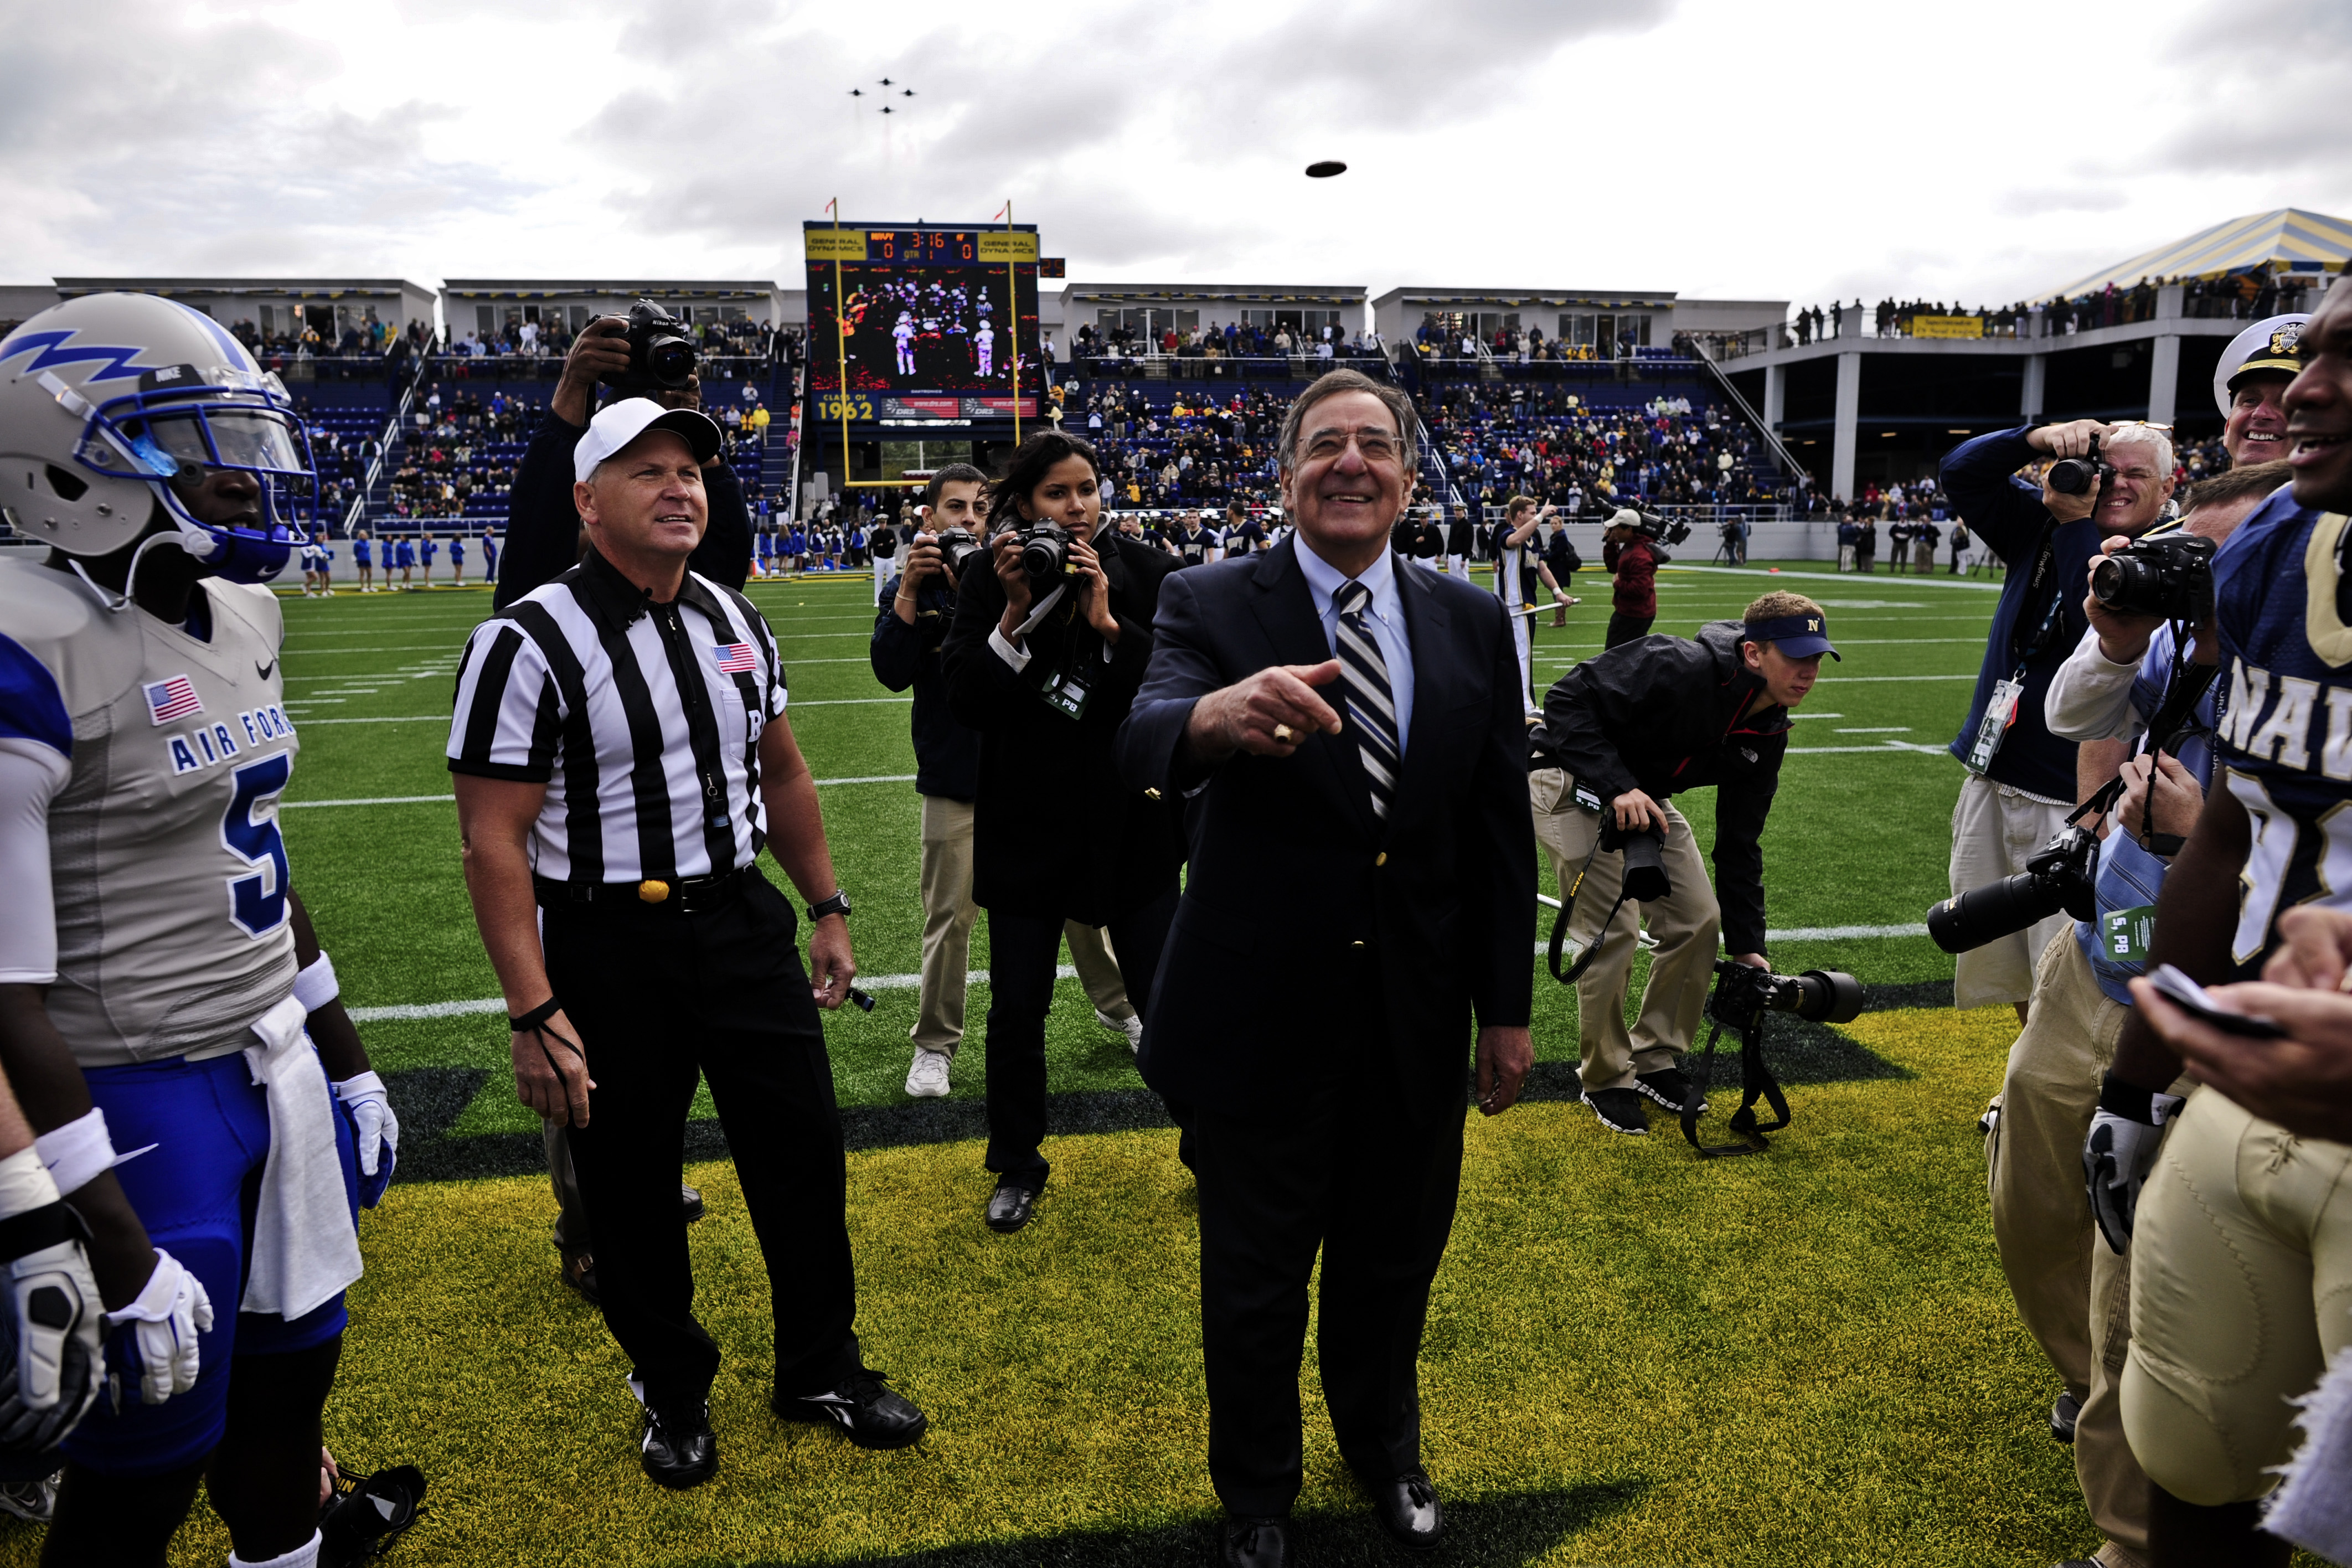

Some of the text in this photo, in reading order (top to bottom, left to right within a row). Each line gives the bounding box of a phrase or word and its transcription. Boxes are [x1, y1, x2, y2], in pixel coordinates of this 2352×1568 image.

[904, 250, 919, 259] QTR
[1041, 259, 1064, 276] 25
[156, 366, 182, 382] NIKE
[818, 402, 873, 419] 1962
[2033, 551, 2051, 588] SmugMug
[1807, 619, 1818, 632] N
[1061, 698, 1078, 712] PB
[747, 709, 762, 742] R
[166, 721, 241, 776] AIR
[220, 748, 290, 940] 5
[1570, 871, 1584, 897] Nikon
[2114, 935, 2129, 953] PB
